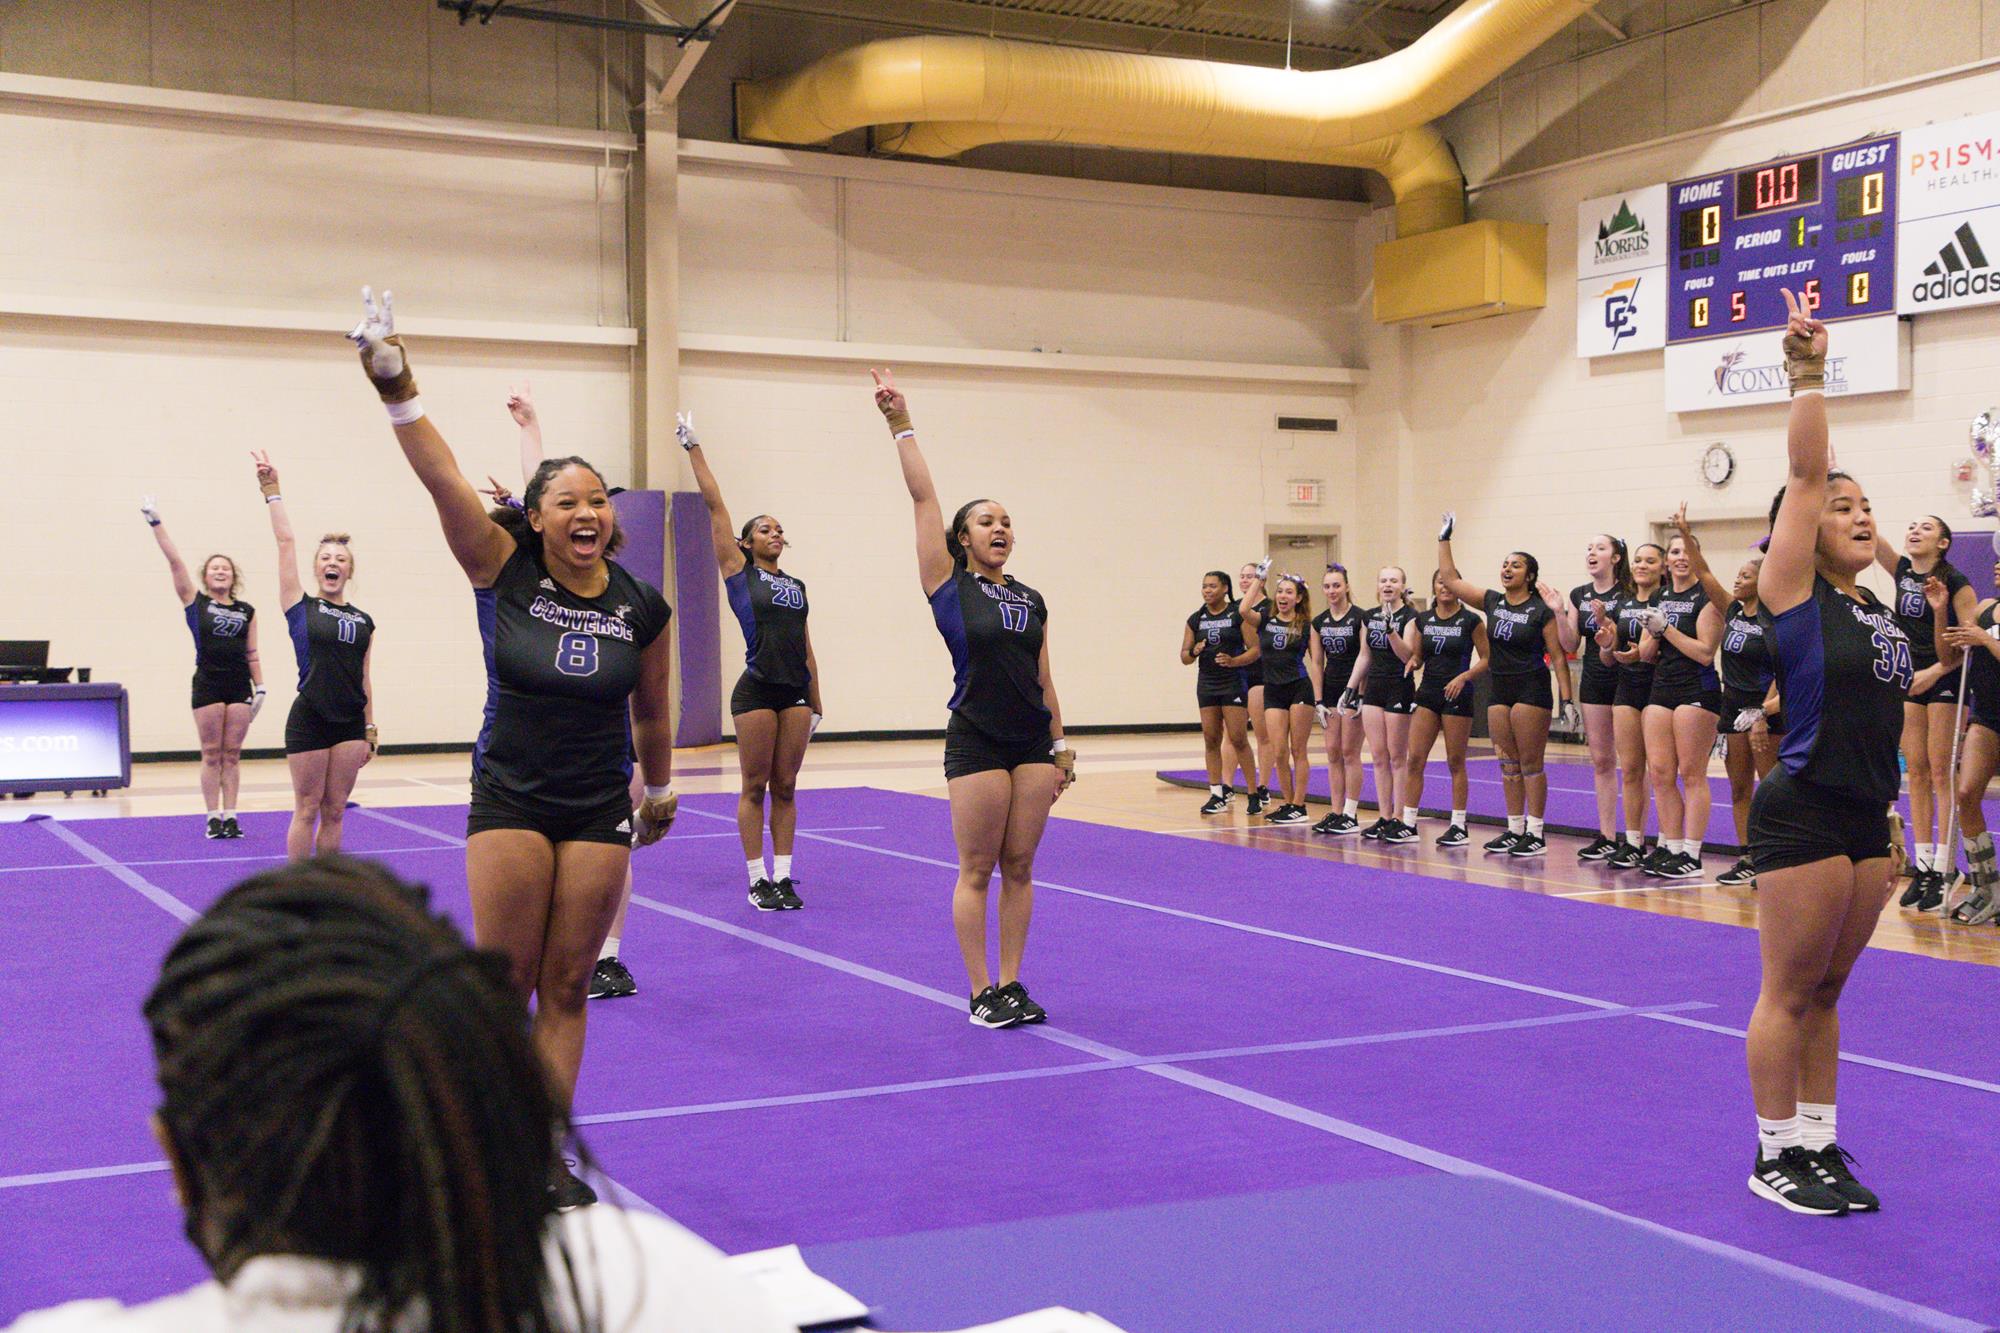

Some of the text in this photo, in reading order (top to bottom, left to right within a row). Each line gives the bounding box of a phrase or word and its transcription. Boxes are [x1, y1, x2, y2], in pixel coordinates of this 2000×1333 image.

[1831, 144, 1890, 173] GUEST
[1910, 138, 2000, 176] PRISM
[1678, 180, 1724, 205] HOME
[1862, 172, 1884, 216] 0
[1702, 205, 1721, 246] 0
[1594, 232, 1649, 259] MORRIS
[1734, 229, 1782, 250] PERIOD
[1737, 259, 1815, 282] TIME OUTS LEFT
[1841, 249, 1876, 265] FOULS
[1684, 276, 1715, 291] FOULS
[1806, 279, 1821, 311] 5
[1852, 272, 1869, 304] 0
[1912, 270, 2000, 303] adidas
[1694, 297, 1709, 328] 0
[1731, 291, 1746, 322] 5
[771, 583, 804, 610] 20
[1900, 592, 1926, 618] 19
[212, 616, 244, 637] 27
[529, 595, 634, 642] CONVERSE
[998, 602, 1029, 633] 17
[1494, 619, 1514, 641] 14
[337, 619, 356, 645] 11
[1208, 628, 1221, 645] 5
[1432, 636, 1446, 655] 7
[1724, 631, 1747, 653] 18
[555, 631, 599, 677] 8
[1871, 630, 1914, 689] 34
[0, 735, 80, 753] s.com
